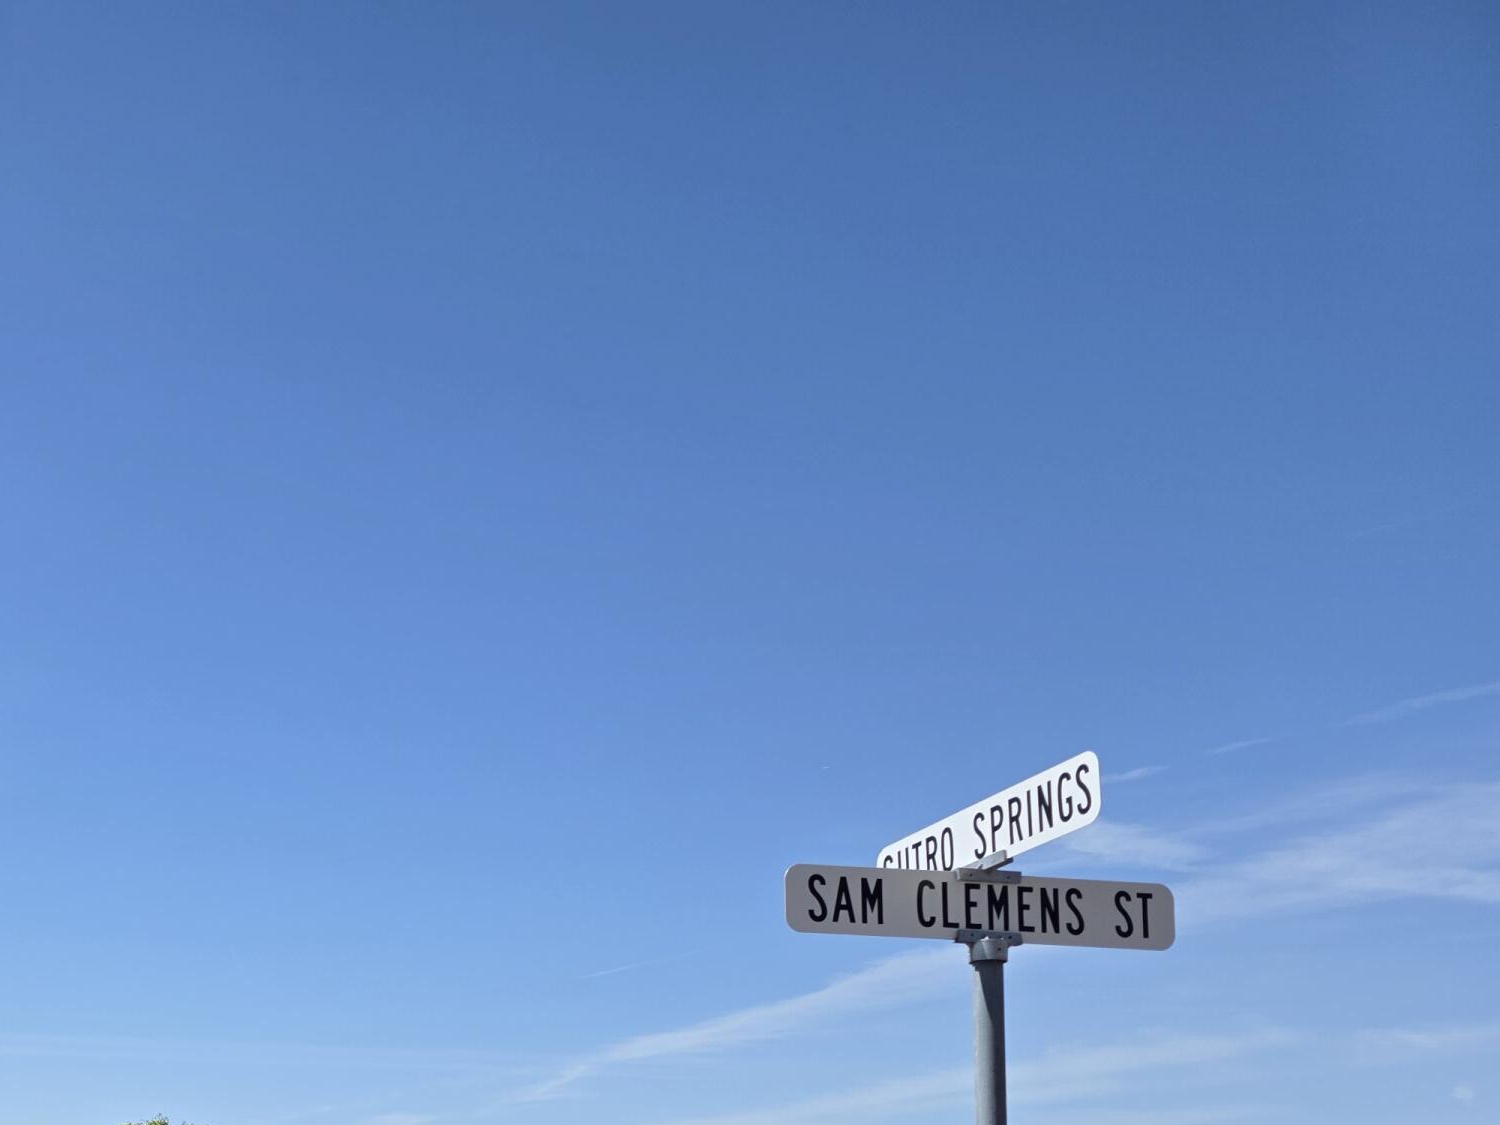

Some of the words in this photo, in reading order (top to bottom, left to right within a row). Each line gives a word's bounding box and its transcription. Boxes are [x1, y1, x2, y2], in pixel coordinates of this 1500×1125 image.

[973, 763, 1092, 859] SPRINGS
[807, 874, 884, 925] SAM
[916, 879, 1085, 936] CLEMENS
[1114, 890, 1153, 939] ST
